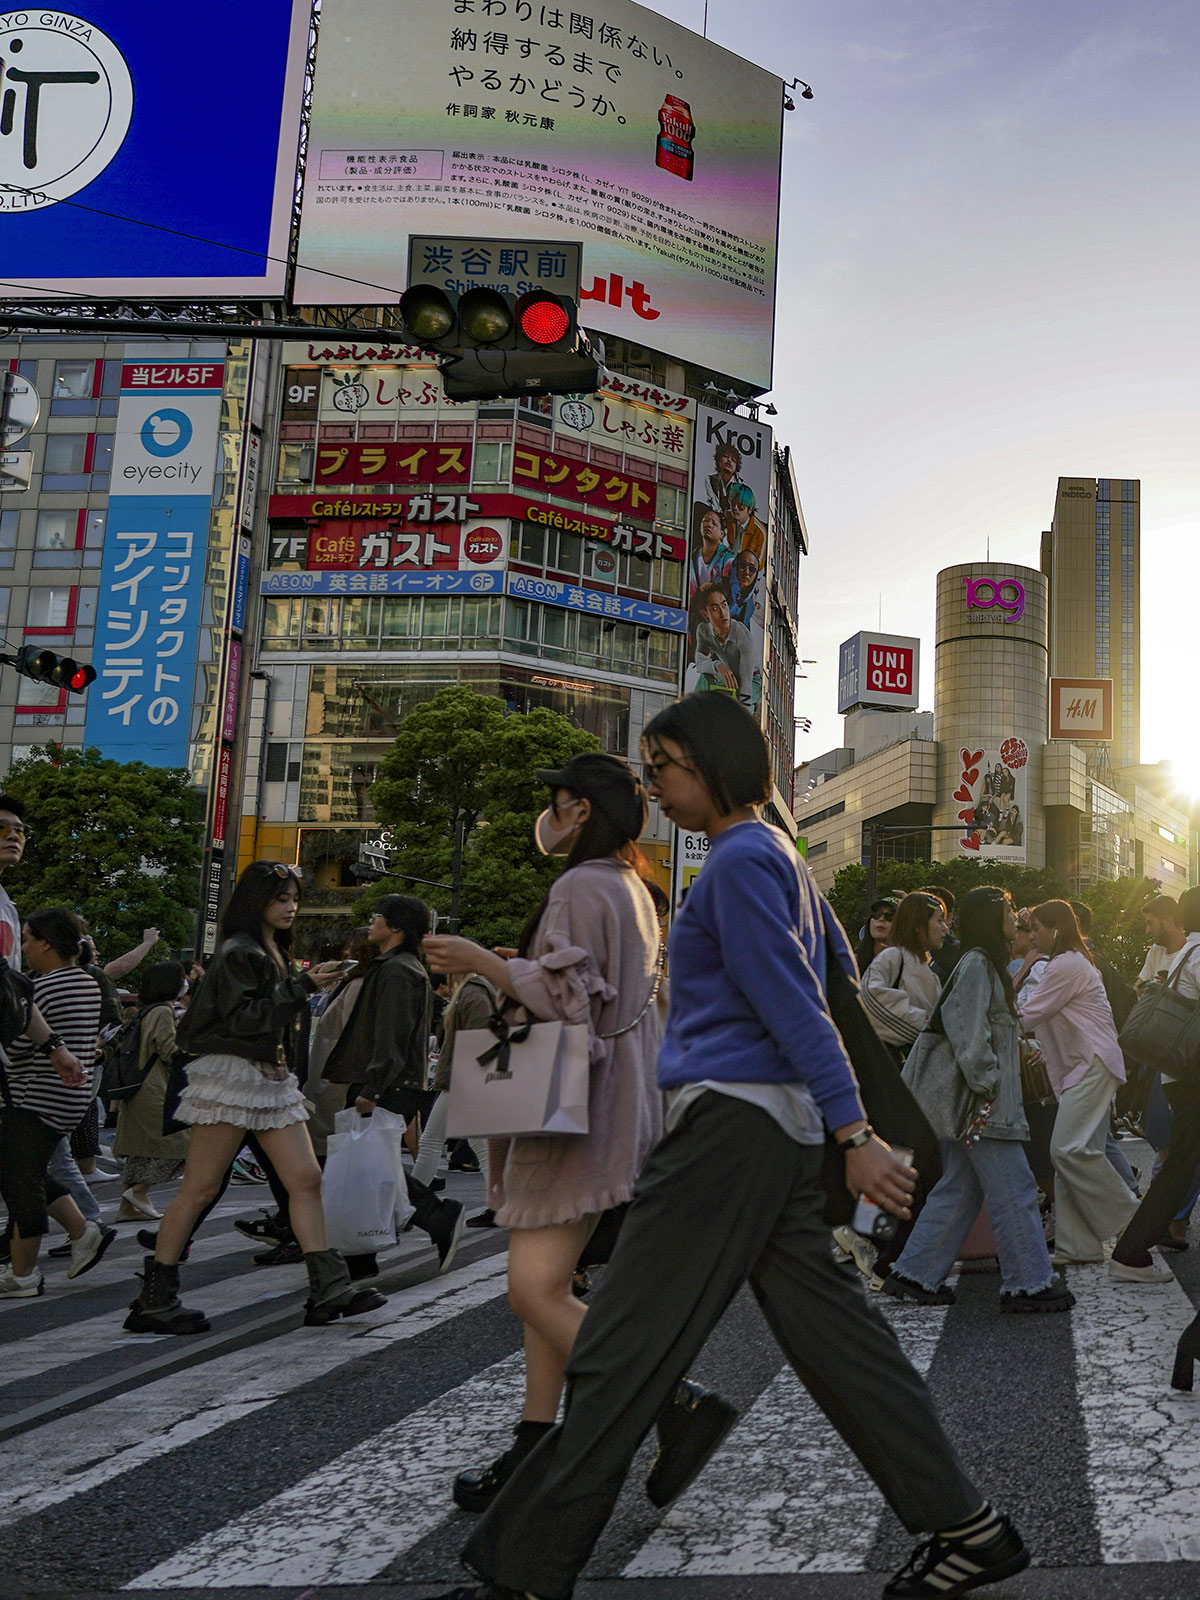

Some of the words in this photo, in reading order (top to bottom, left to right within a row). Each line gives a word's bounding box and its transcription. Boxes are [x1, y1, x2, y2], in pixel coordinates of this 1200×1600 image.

[0, 13, 28, 28] YO
[40, 13, 93, 42] GINZA
[453, 0, 683, 79] まわりは関係ない。
[450, 27, 622, 84] 納得するまで
[449, 65, 627, 125] やるかどうか。
[446, 103, 496, 120] 作詞家
[505, 109, 556, 131] 秋元康
[662, 112, 692, 133] Yakult
[662, 122, 691, 143] 1000
[346, 155, 418, 164] 機能性表示食品
[422, 245, 567, 278] 渋谷駅前
[580, 273, 661, 320] ult
[131, 366, 214, 387] 当ビル5F
[288, 385, 317, 403] 9F
[376, 378, 464, 406] しゃぶ
[603, 404, 685, 453] しゃぶ葉
[706, 416, 762, 460] Kroi
[123, 461, 203, 485] eyecity
[319, 447, 467, 476] プライス
[514, 450, 651, 509] コンタクト
[311, 500, 402, 517] Caféレストラン
[407, 494, 480, 522] ガスト
[1062, 491, 1092, 499] INDIGO
[315, 536, 356, 553] Café
[527, 505, 608, 540] Caféレストラン
[611, 524, 673, 559] ガスト
[272, 537, 308, 559] 7F
[315, 553, 353, 563] レストラン
[358, 530, 451, 568] ガスト
[469, 543, 499, 554] ガスト
[268, 574, 314, 590] AEON
[328, 573, 463, 592] 英会話イーオン
[472, 575, 493, 590] 6F
[515, 576, 558, 599] AEON
[568, 587, 684, 627] 英会話イーオン
[962, 577, 1025, 623] 109
[102, 532, 158, 727] アイシティ
[147, 532, 194, 727] コンタクトの
[872, 650, 904, 670] UNI
[871, 669, 907, 689] QLO
[1066, 698, 1097, 720] H&M
[685, 835, 710, 852] 6.19
[357, 1228, 390, 1238] RAGTAG
